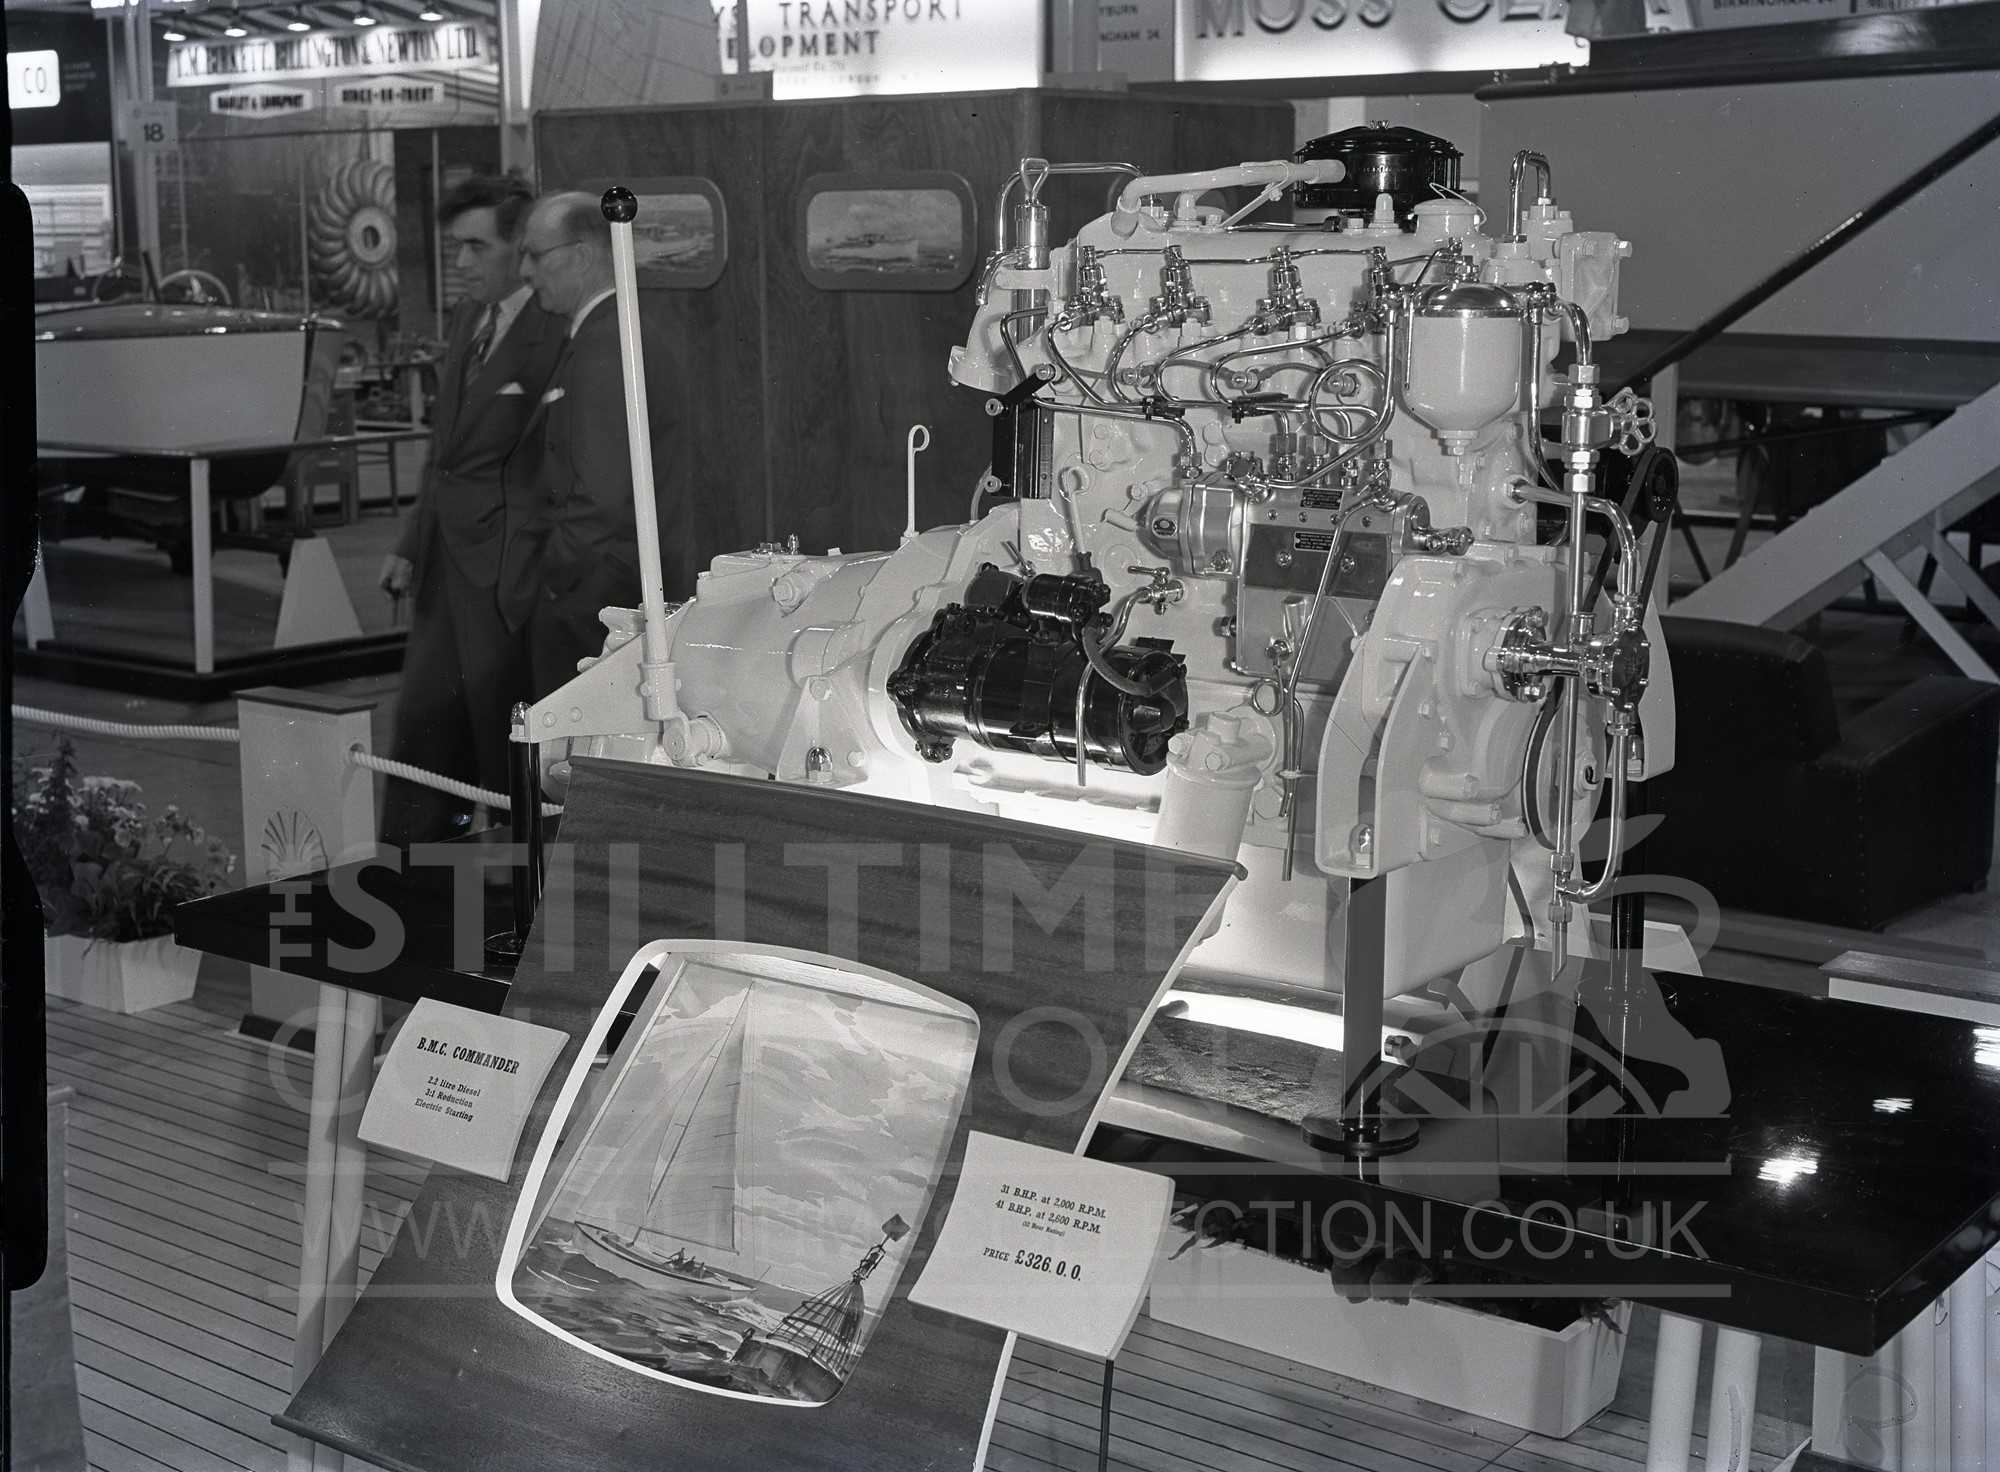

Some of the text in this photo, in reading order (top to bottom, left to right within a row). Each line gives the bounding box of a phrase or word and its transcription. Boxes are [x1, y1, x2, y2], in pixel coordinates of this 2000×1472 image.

[144, 122, 165, 142] 18
[417, 1036, 520, 1075] B.M.C. COMMANDER
[440, 1079, 456, 1090] litre
[457, 1083, 481, 1097] Diesel
[415, 1097, 474, 1122] Electric Starting
[437, 1091, 473, 1108] Reduction
[1000, 1183, 1106, 1219] 31 B.H.P. at 2,000 R.P.M.
[995, 1199, 1005, 1209] 41
[1008, 1202, 1032, 1217] B.H.P.
[1035, 1211, 1046, 1220] at
[1073, 1218, 1101, 1234] R.P.M.
[983, 1247, 1010, 1262] PRICE
